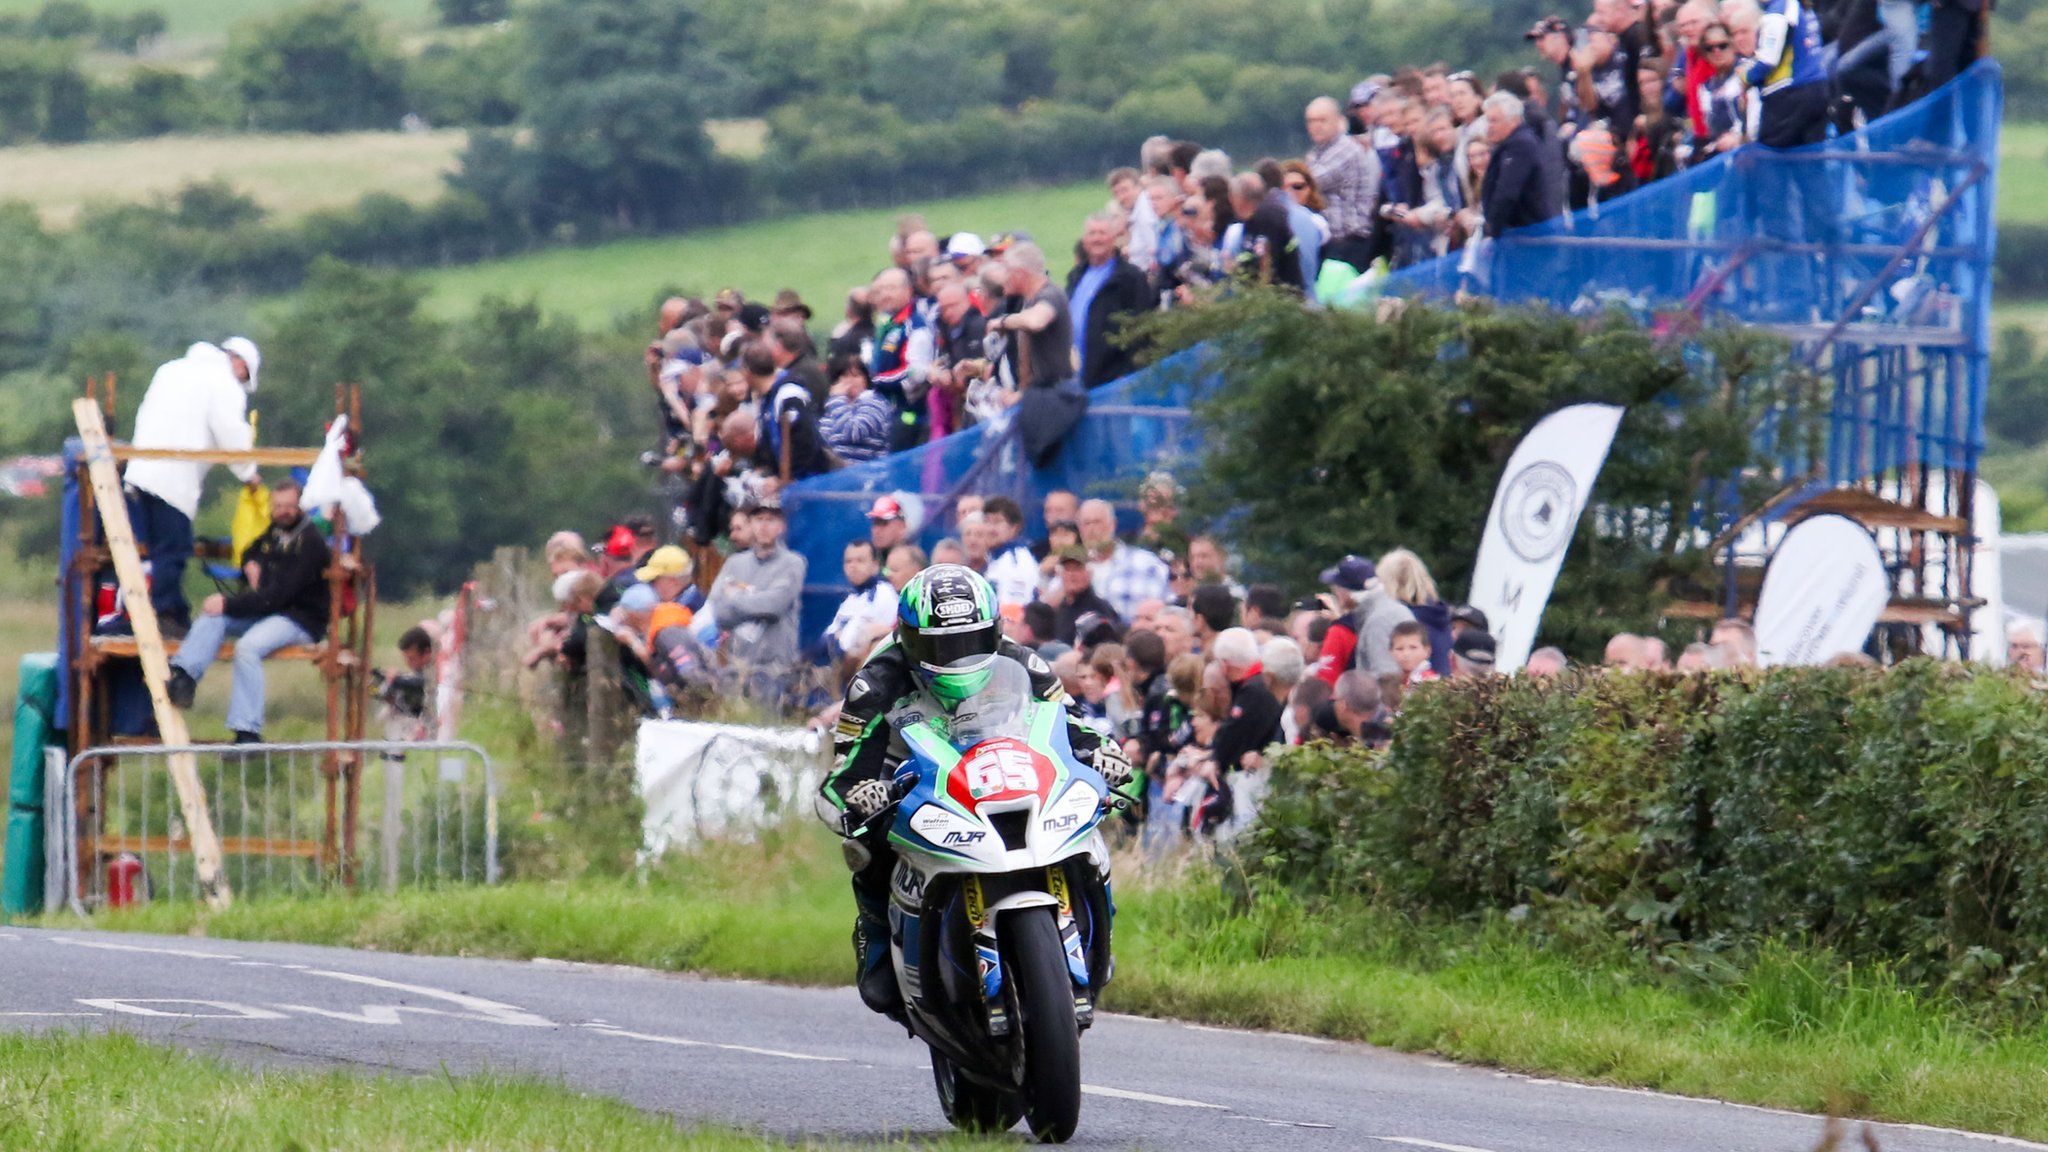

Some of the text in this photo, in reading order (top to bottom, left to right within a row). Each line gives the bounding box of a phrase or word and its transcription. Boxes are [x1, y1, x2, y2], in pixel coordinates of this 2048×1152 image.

[965, 748, 1040, 800] 65
[1043, 813, 1079, 832] MJR
[942, 831, 987, 844] MJR
